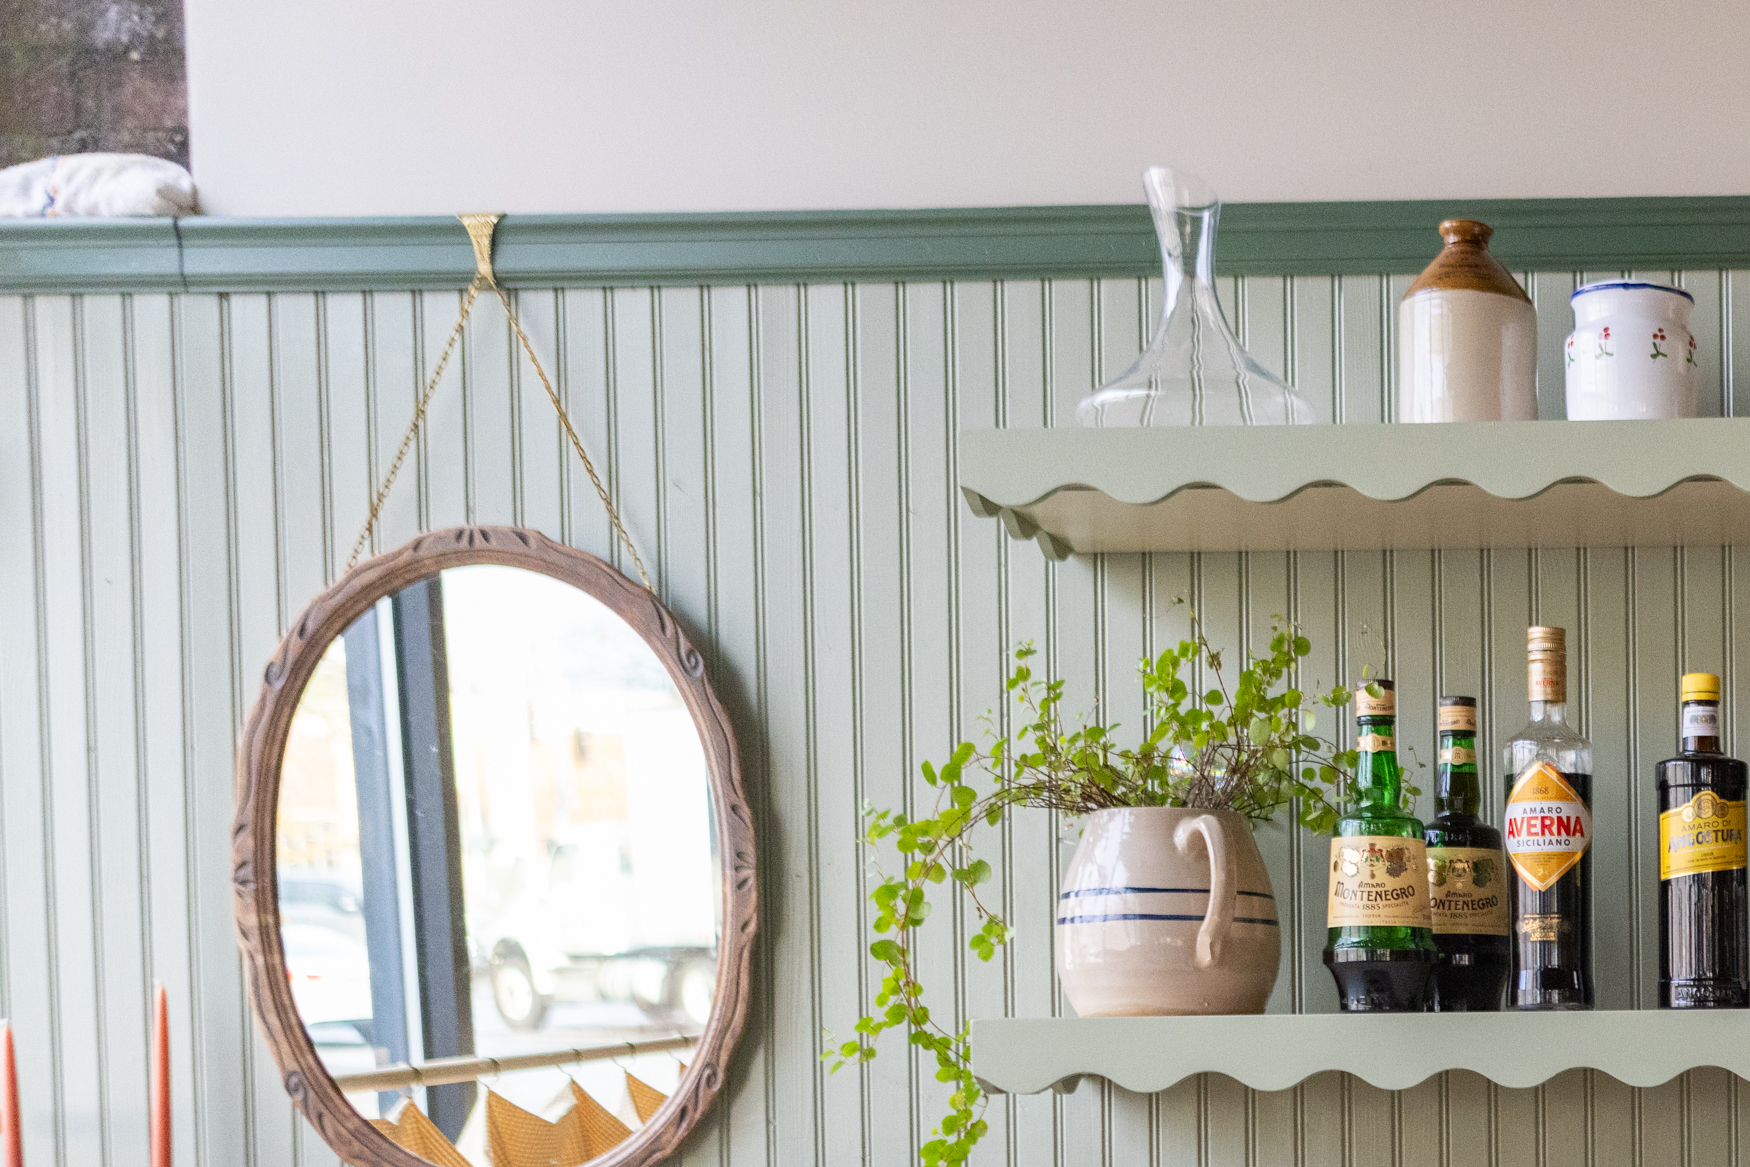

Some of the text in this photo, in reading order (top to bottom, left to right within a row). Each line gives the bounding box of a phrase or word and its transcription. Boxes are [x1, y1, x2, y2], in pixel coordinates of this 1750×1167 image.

[1532, 787, 1549, 795] 1868
[1522, 806, 1563, 815] AMARO
[1507, 816, 1585, 839] AVERNA
[1681, 820, 1731, 832] AMARO DI
[1517, 838, 1571, 848] SICILIANO
[1668, 829, 1742, 853] ANGOSTURA
[1335, 881, 1416, 902] MONTENEGRO
[1430, 895, 1499, 911] ONTENEGRO
